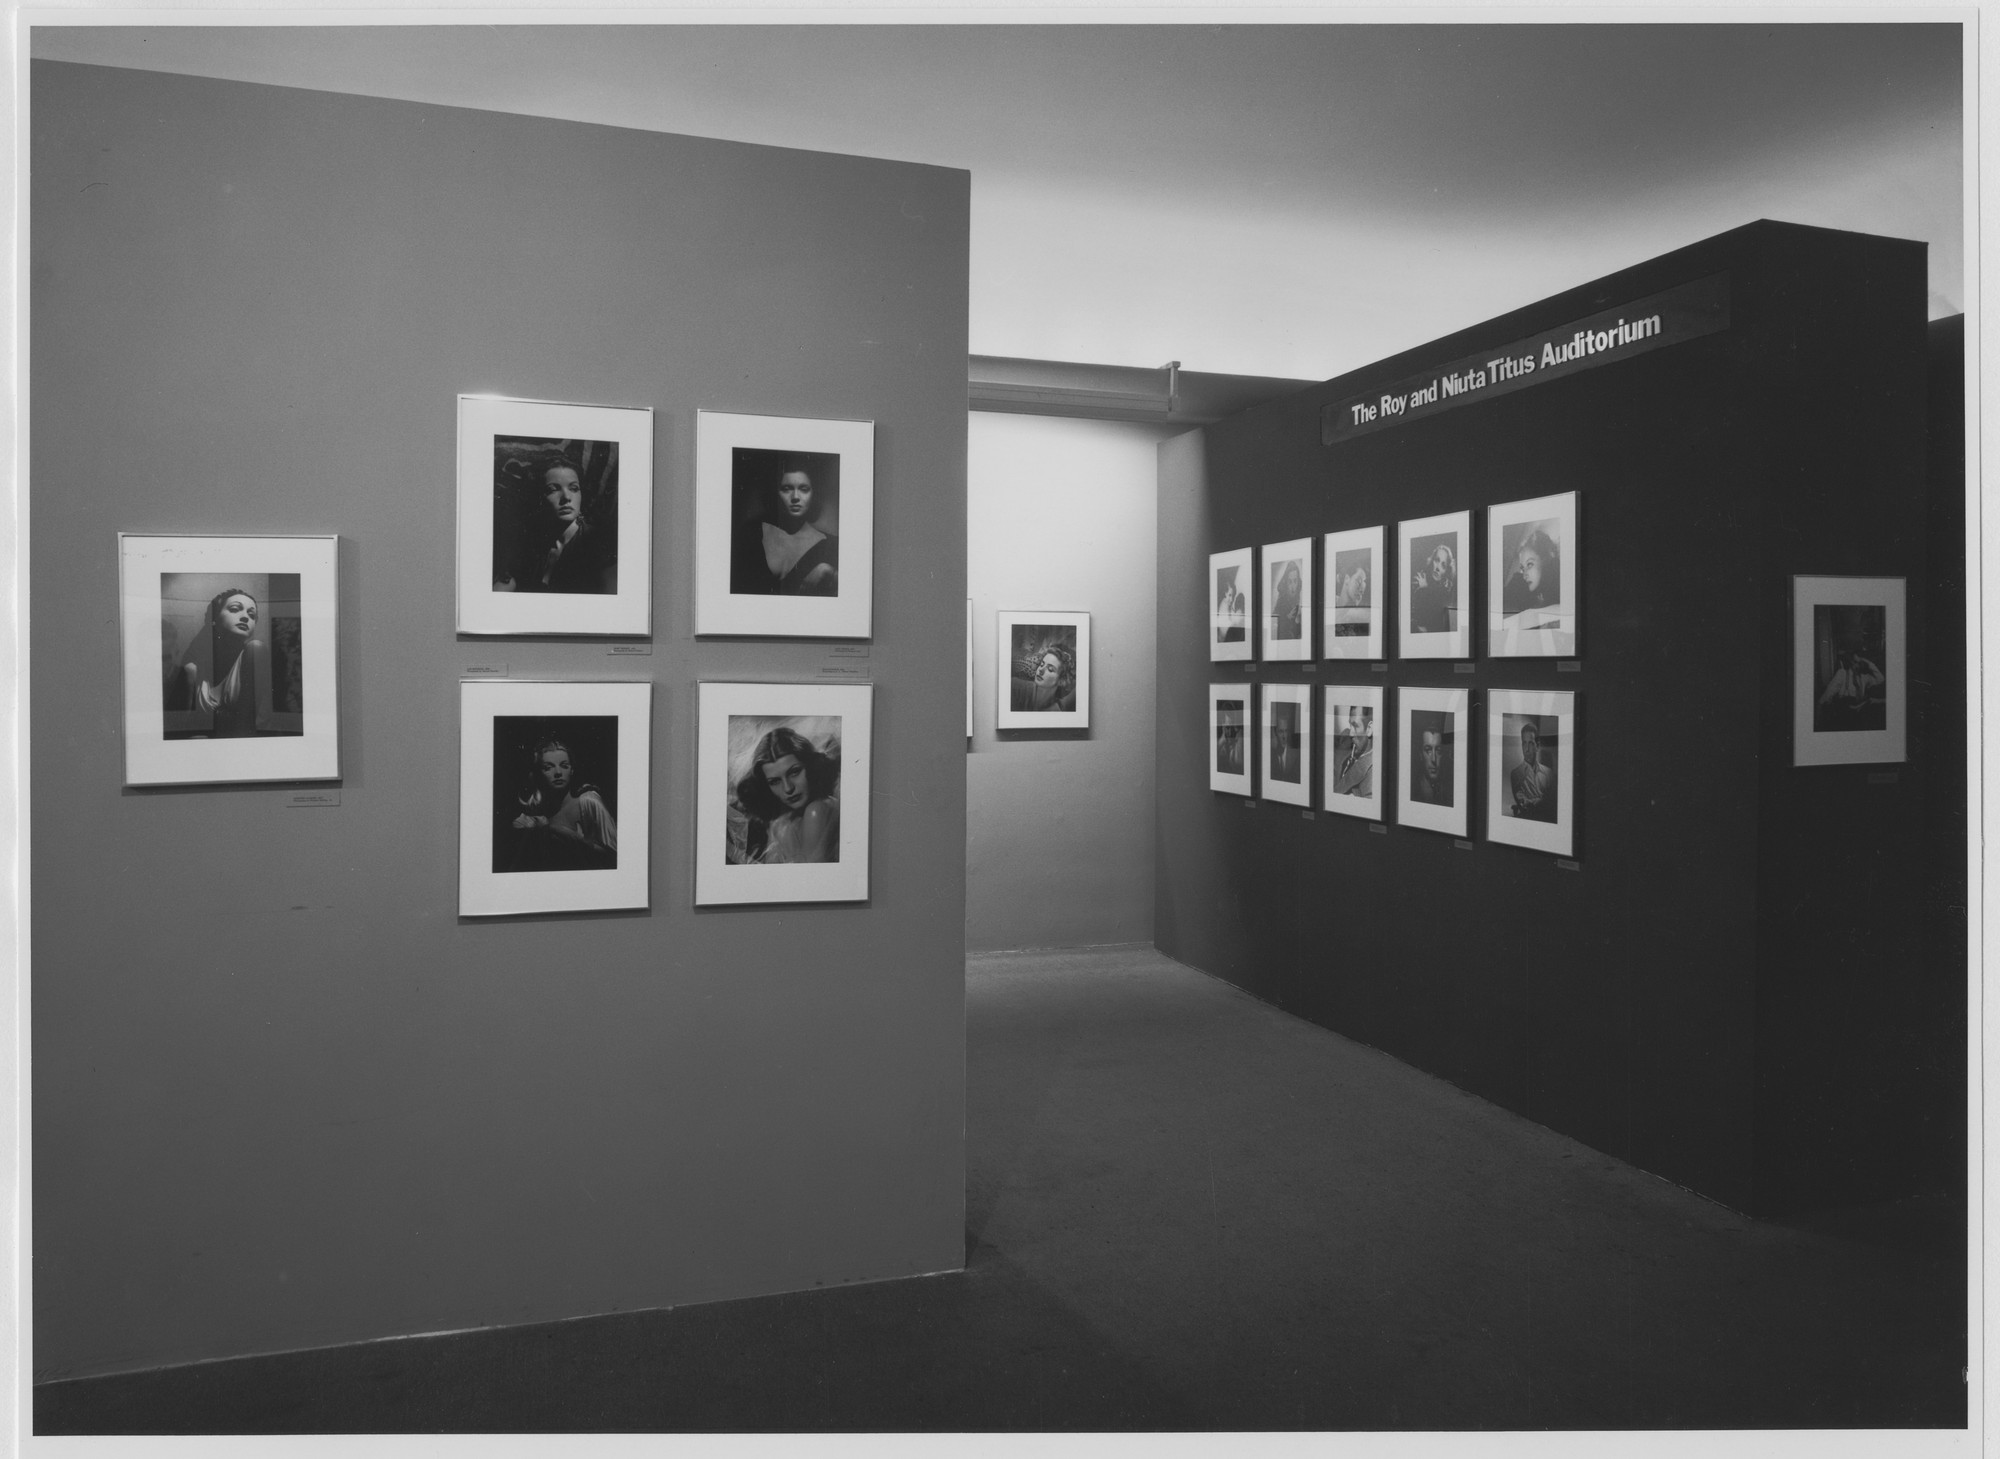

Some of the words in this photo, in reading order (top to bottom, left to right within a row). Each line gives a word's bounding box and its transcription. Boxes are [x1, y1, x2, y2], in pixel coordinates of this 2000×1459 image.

[1351, 402, 1378, 426] The
[1380, 394, 1408, 418] Roy
[1410, 380, 1438, 409] and
[1441, 368, 1486, 399] Niuta
[1486, 354, 1536, 384] Titus
[1540, 314, 1661, 370] Auditorium
